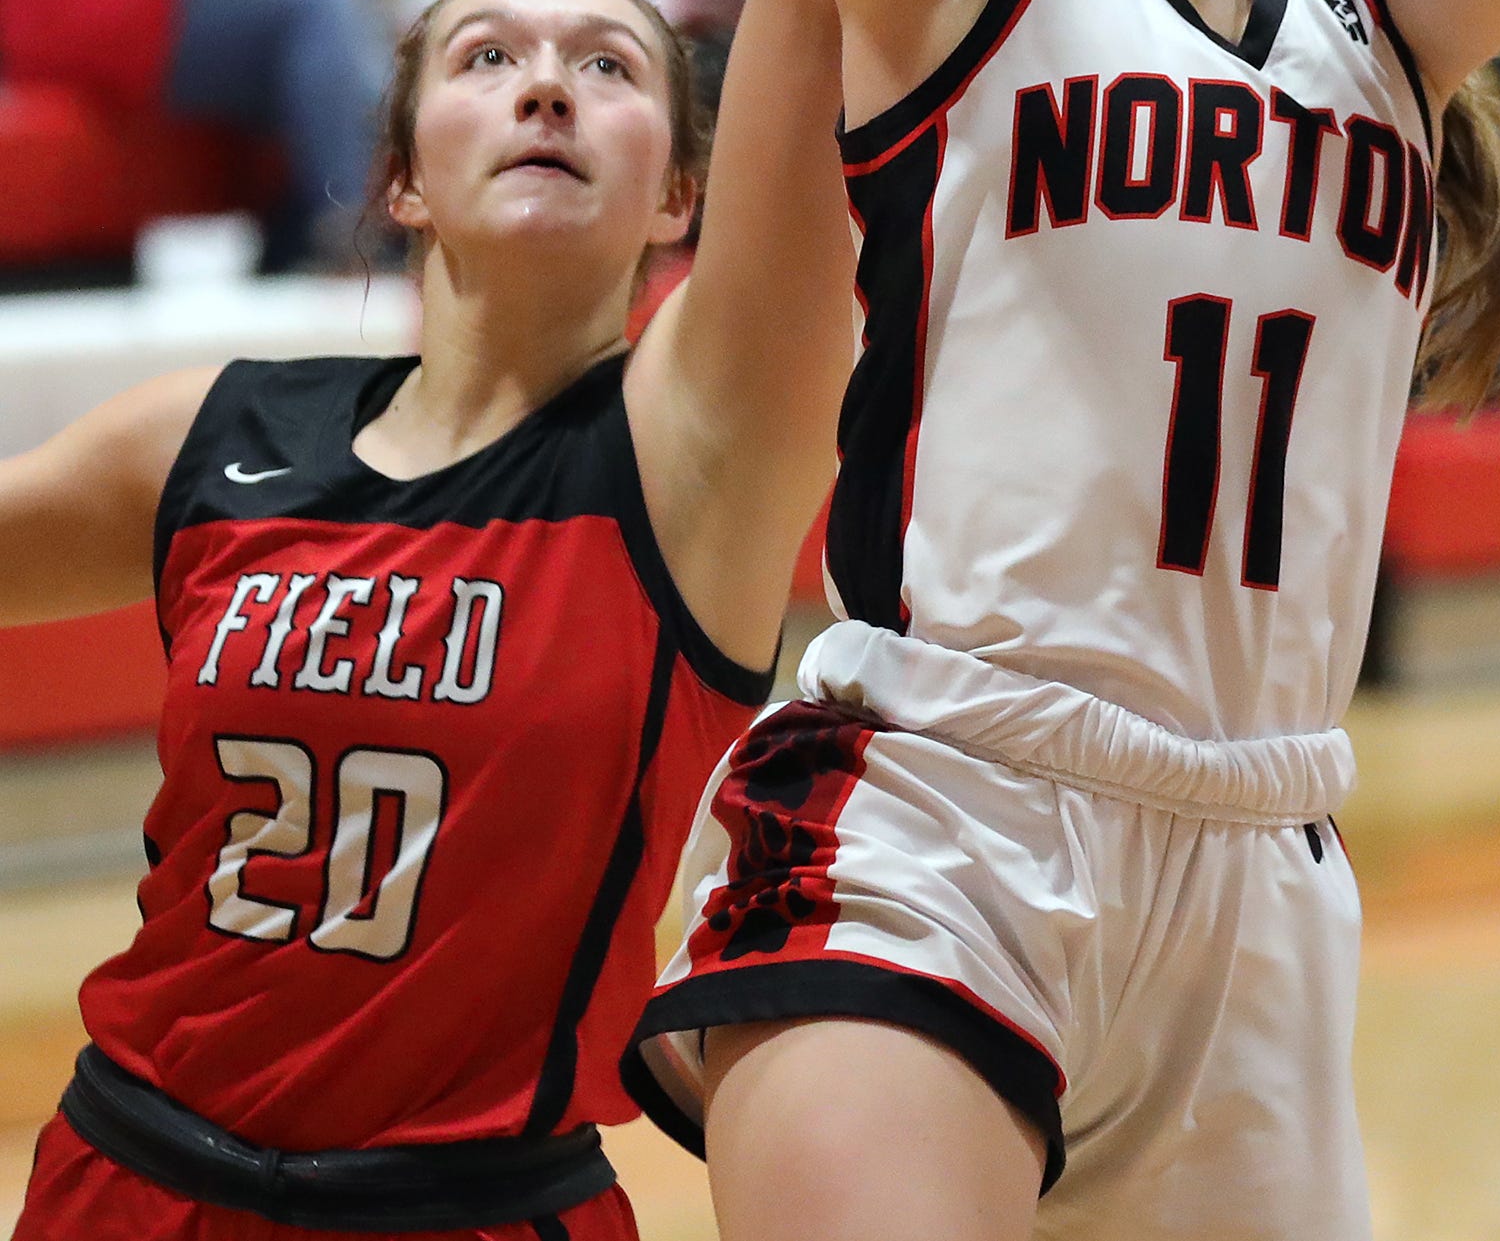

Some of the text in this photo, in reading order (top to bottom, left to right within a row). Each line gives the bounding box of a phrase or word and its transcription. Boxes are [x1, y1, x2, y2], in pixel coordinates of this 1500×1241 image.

[1005, 73, 1435, 308] NORTON
[1157, 293, 1316, 591] 11
[198, 573, 504, 703] FIELD
[205, 733, 449, 963] 20
